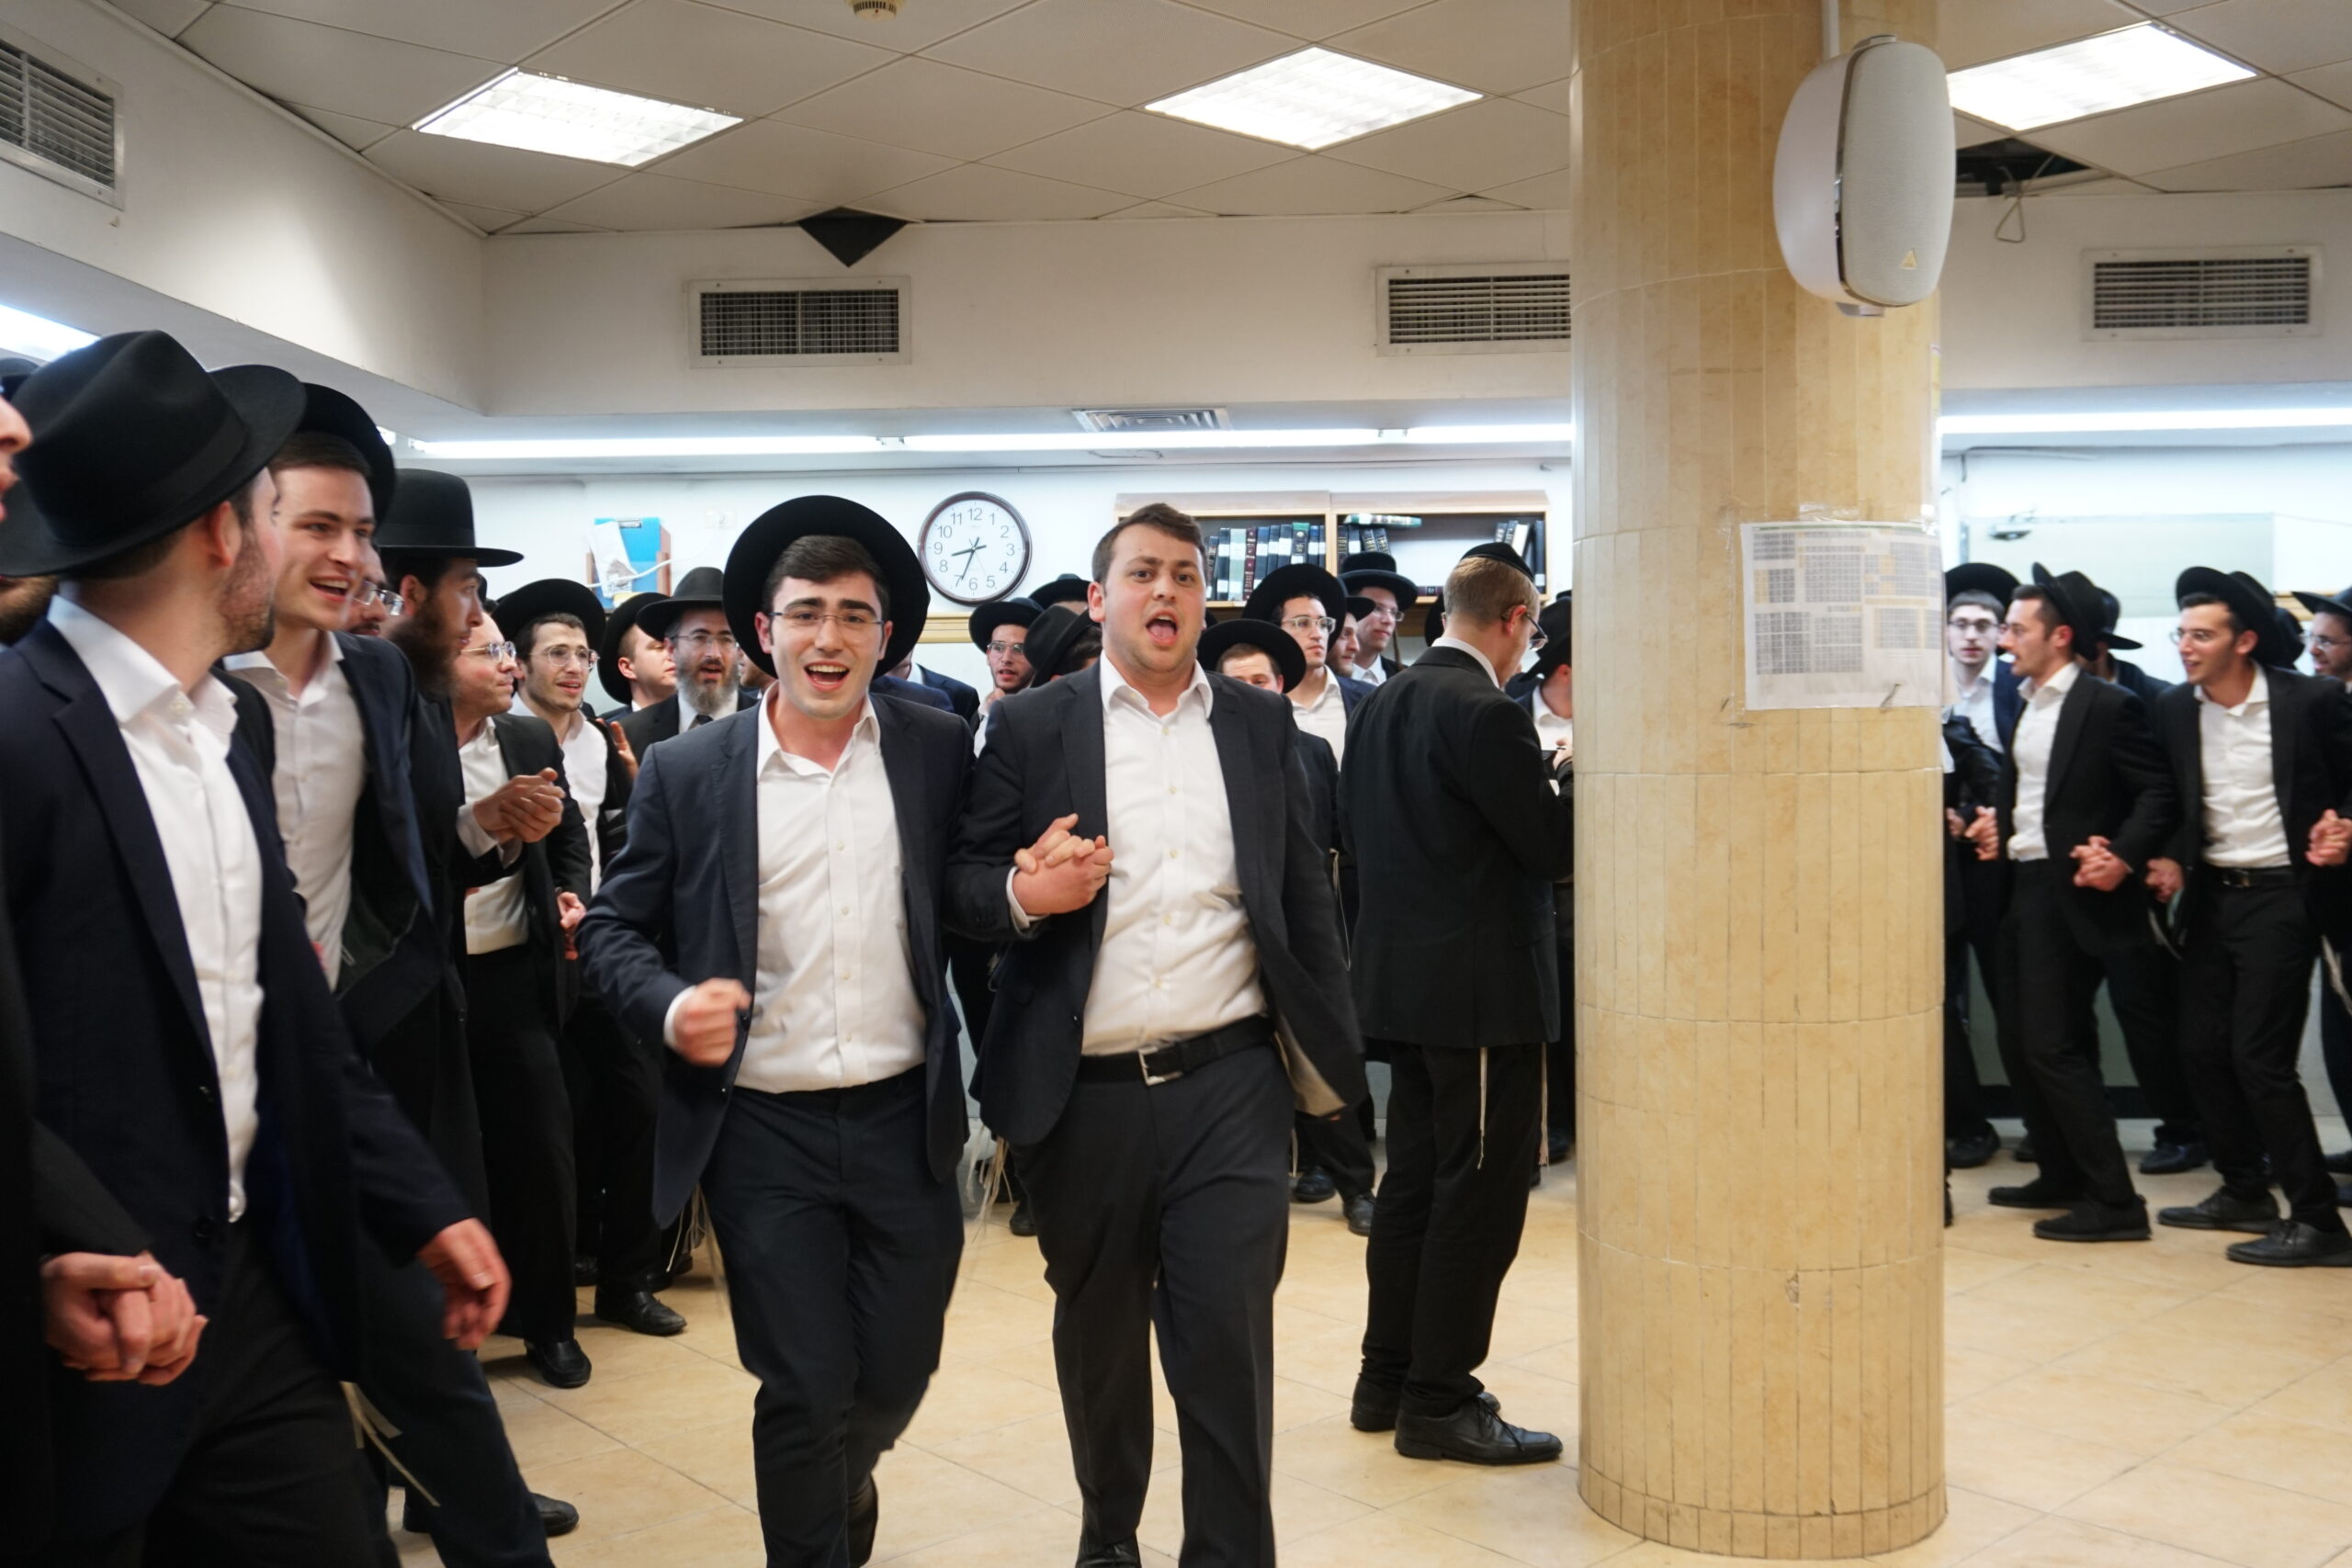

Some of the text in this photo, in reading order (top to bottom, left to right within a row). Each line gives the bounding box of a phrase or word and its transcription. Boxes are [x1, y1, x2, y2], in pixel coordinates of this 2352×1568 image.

[951, 513, 962, 525] 11
[967, 508, 983, 521] 12
[989, 513, 995, 525] 1
[938, 525, 952, 538] 10
[1001, 525, 1009, 538] 2
[933, 542, 943, 555] 9
[1006, 543, 1014, 556] 3
[939, 559, 948, 572] 8
[1000, 561, 1008, 573] 4
[954, 574, 963, 587] 7
[969, 578, 978, 591] 6
[986, 575, 995, 588] 5
